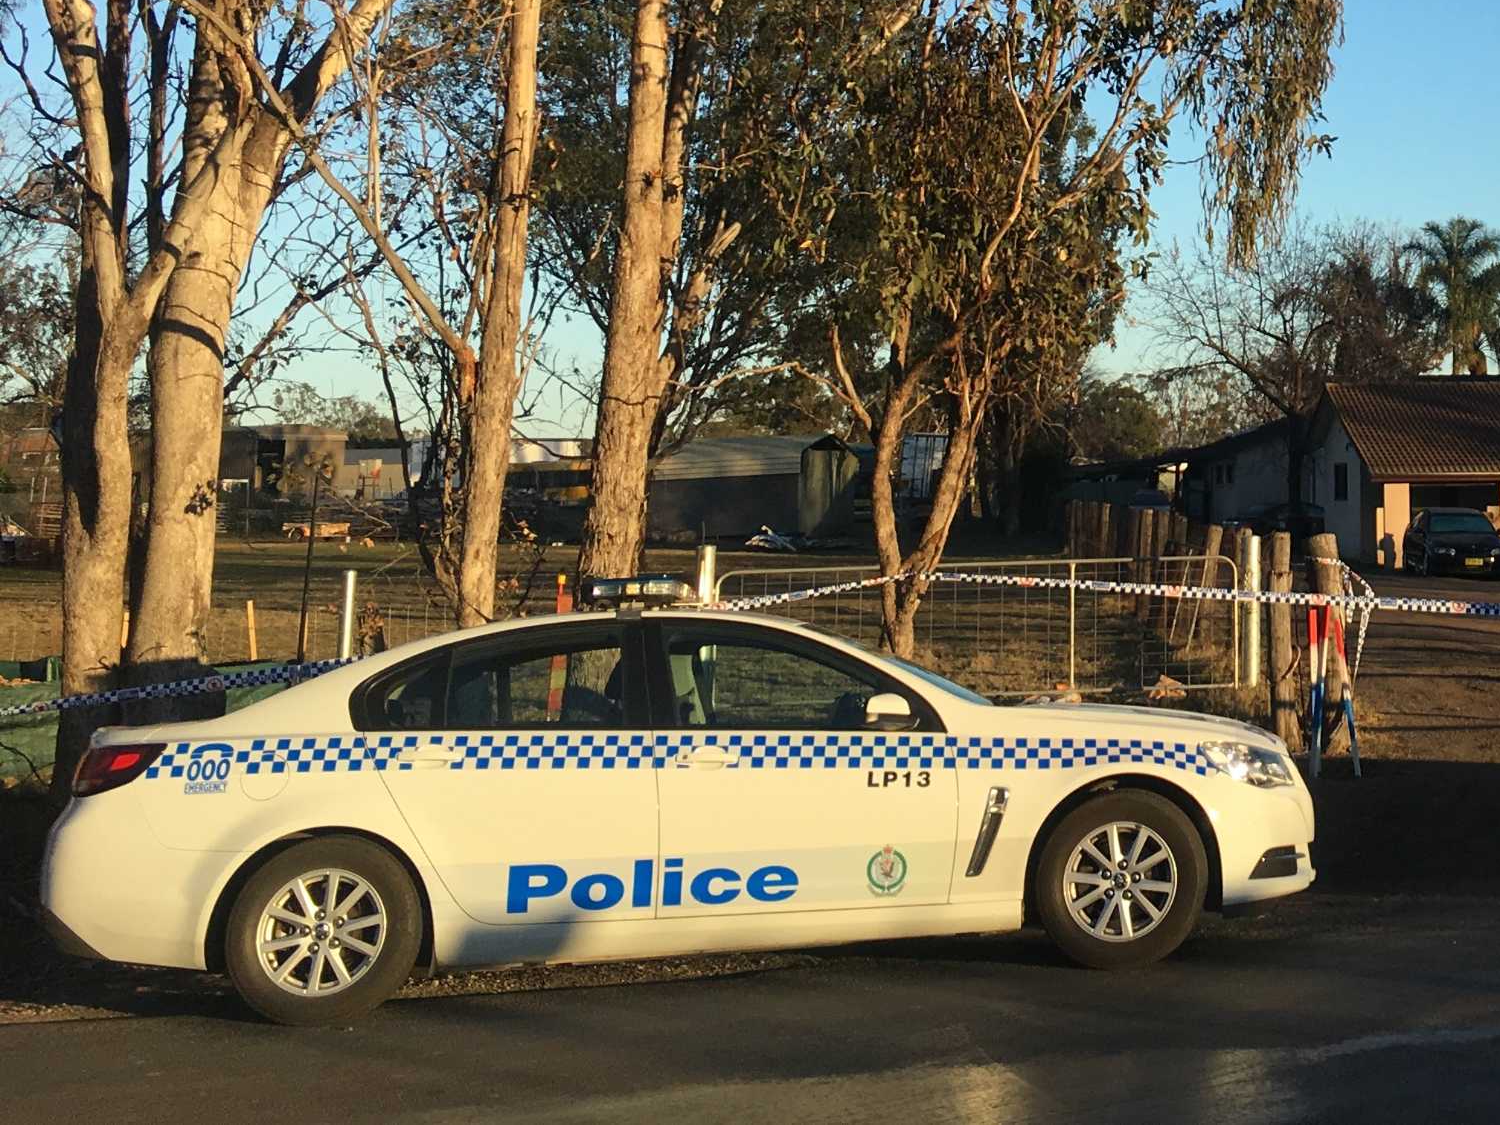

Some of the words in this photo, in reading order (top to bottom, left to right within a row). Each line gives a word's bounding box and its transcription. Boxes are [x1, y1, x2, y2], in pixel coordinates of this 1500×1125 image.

[186, 758, 231, 781] 000
[867, 770, 931, 788] LP13
[506, 858, 799, 914] Police
